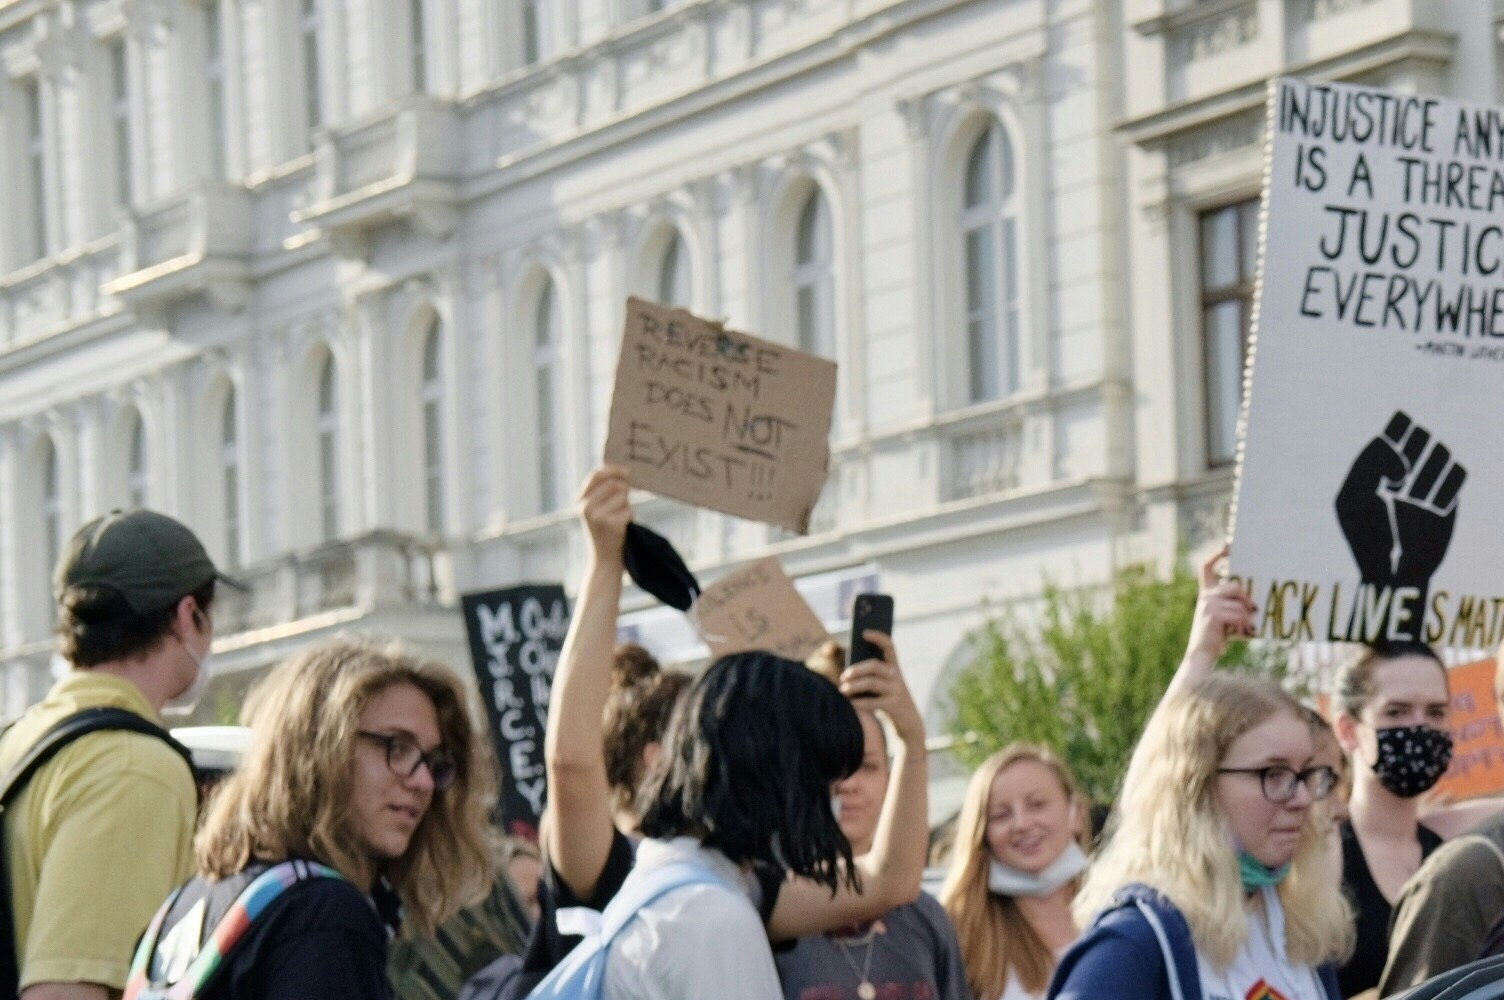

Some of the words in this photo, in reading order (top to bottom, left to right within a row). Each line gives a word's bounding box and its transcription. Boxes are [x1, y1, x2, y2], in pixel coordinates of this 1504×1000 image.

[1279, 82, 1440, 153] INJUSTICE
[1295, 144, 1328, 192] IS
[1347, 153, 1374, 199] A
[635, 343, 760, 400] RACISM
[646, 380, 713, 424] DOES
[722, 404, 798, 449] NOT
